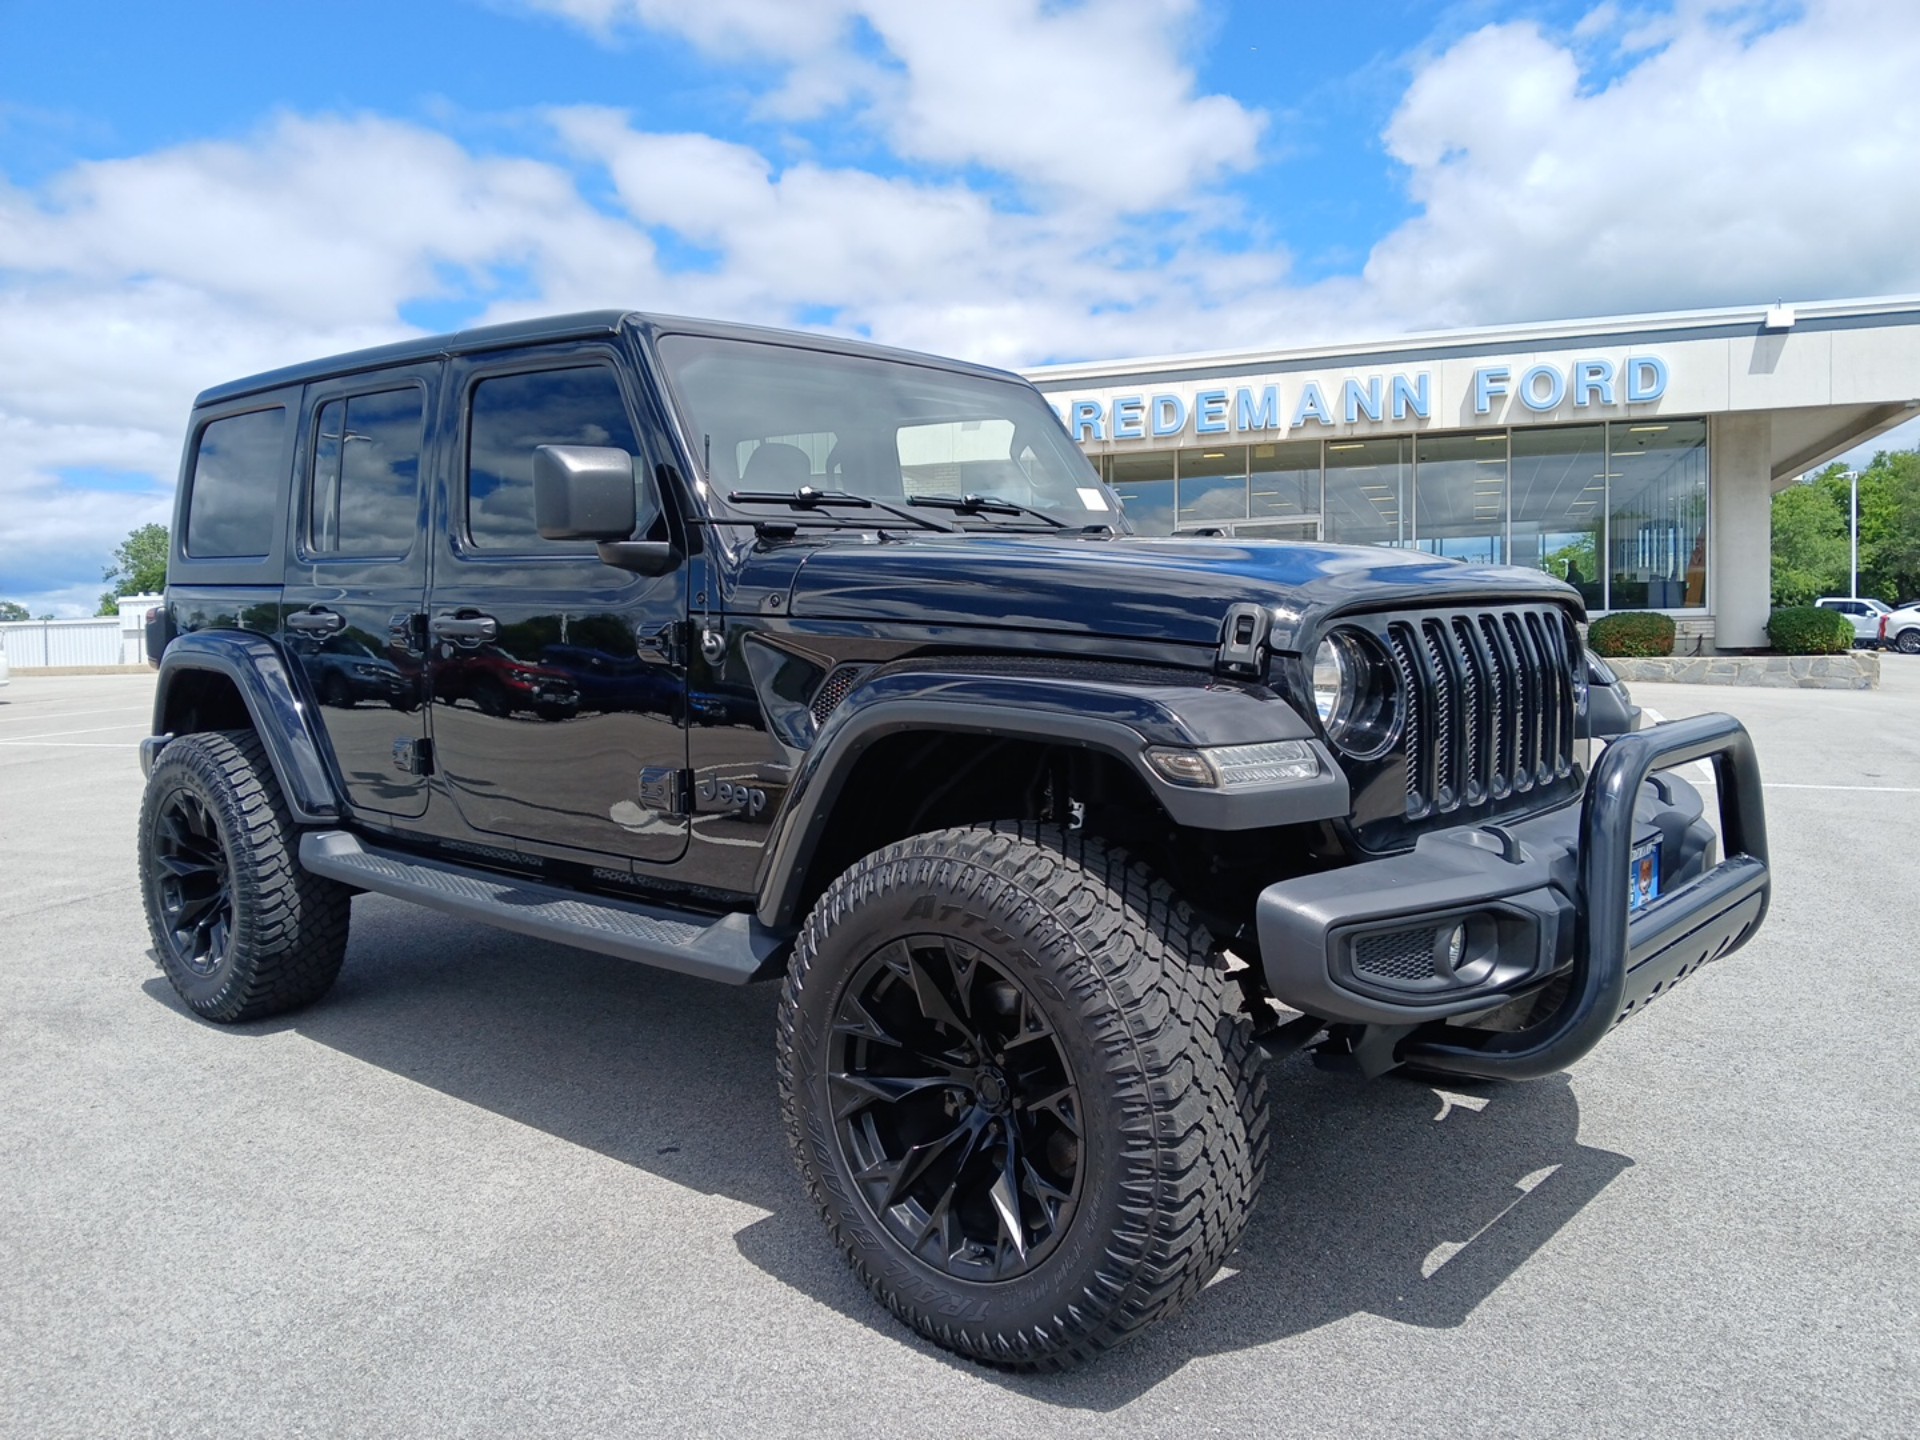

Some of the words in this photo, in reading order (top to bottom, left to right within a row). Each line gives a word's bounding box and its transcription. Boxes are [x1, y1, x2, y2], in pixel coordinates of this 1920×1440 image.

[1050, 371, 1430, 443] REDEMANN
[1473, 354, 1670, 416] FORD
[699, 772, 767, 817] Jeep
[902, 894, 1066, 1002] ATTURO
[801, 1104, 888, 1251] BLADE
[882, 1257, 991, 1324] TRAIL
